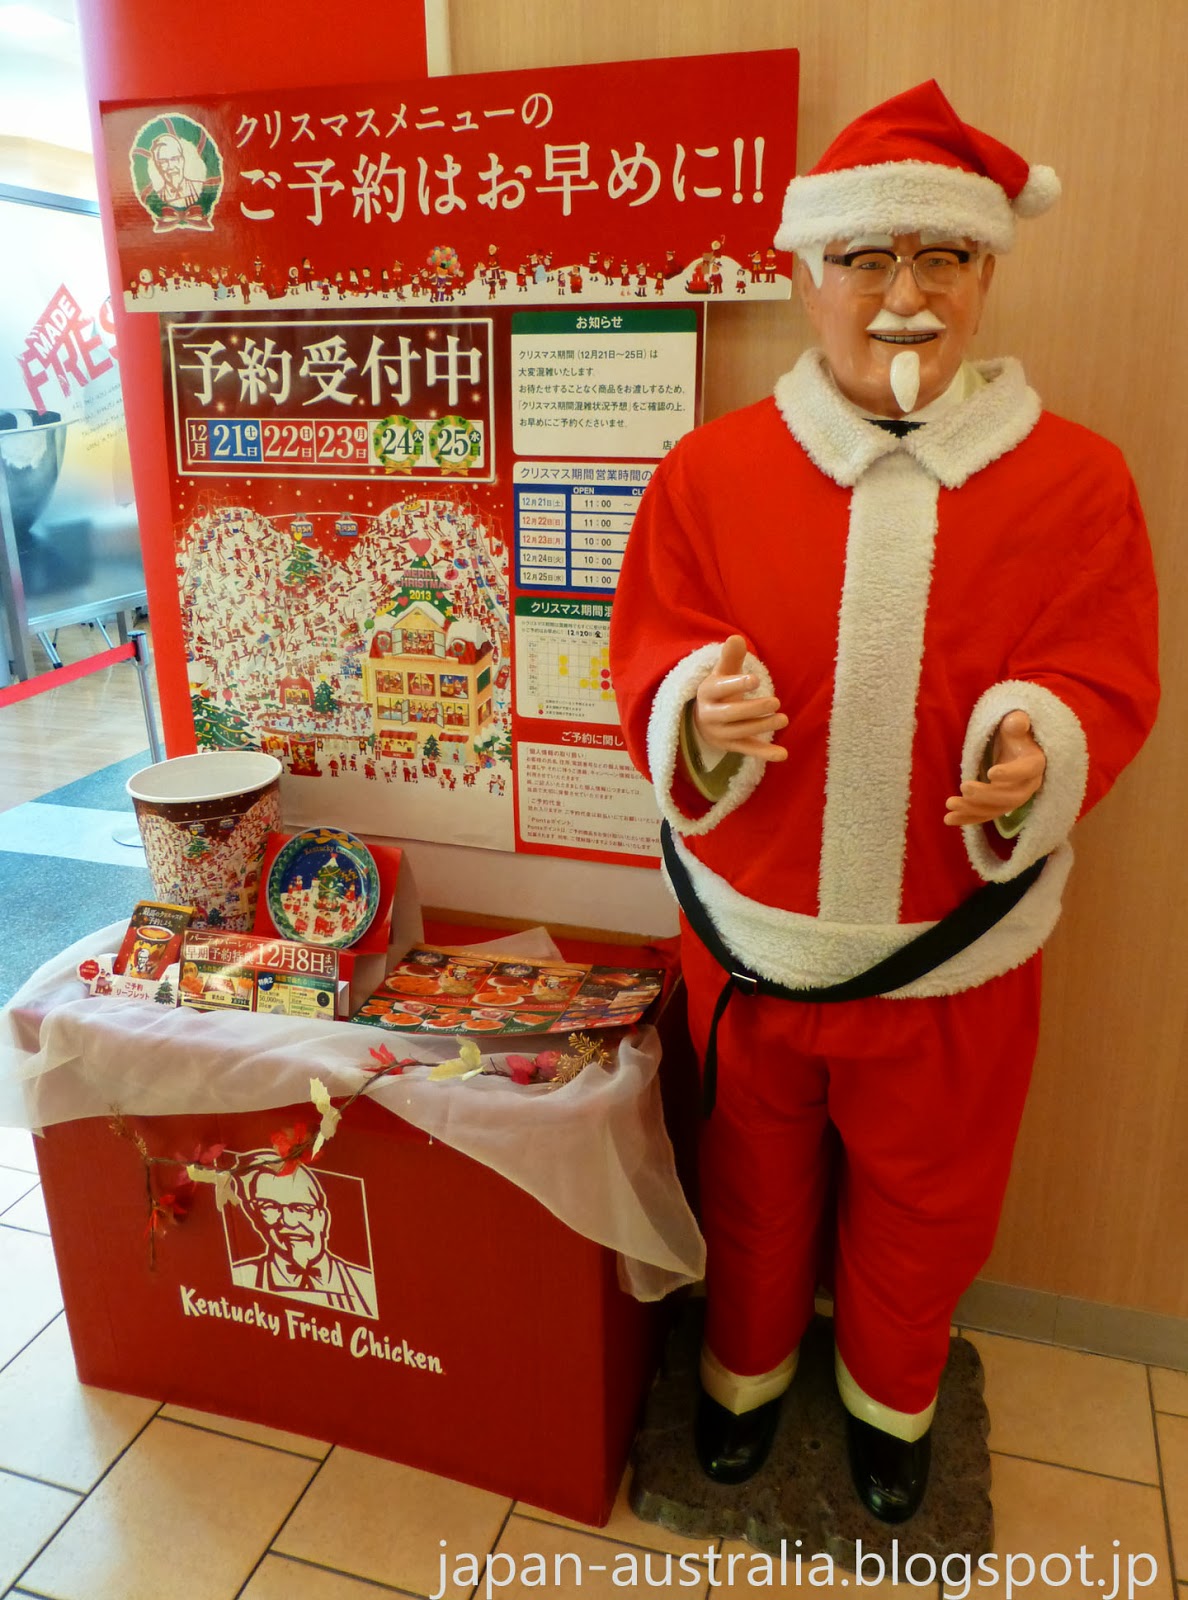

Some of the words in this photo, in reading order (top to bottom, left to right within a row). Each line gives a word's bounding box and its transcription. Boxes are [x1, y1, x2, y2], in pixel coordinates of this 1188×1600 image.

[234, 93, 554, 149] クリスマスメニューの
[33, 294, 76, 360] MADE
[575, 316, 624, 330] お知らせ
[179, 334, 483, 407] 予約受付中
[573, 487, 595, 495] OPEN
[409, 590, 432, 601] 2013
[116, 989, 150, 1001] リーフレット
[179, 1285, 281, 1337] Kentucky
[285, 1309, 344, 1348] Fried
[349, 1326, 444, 1375] Chicken
